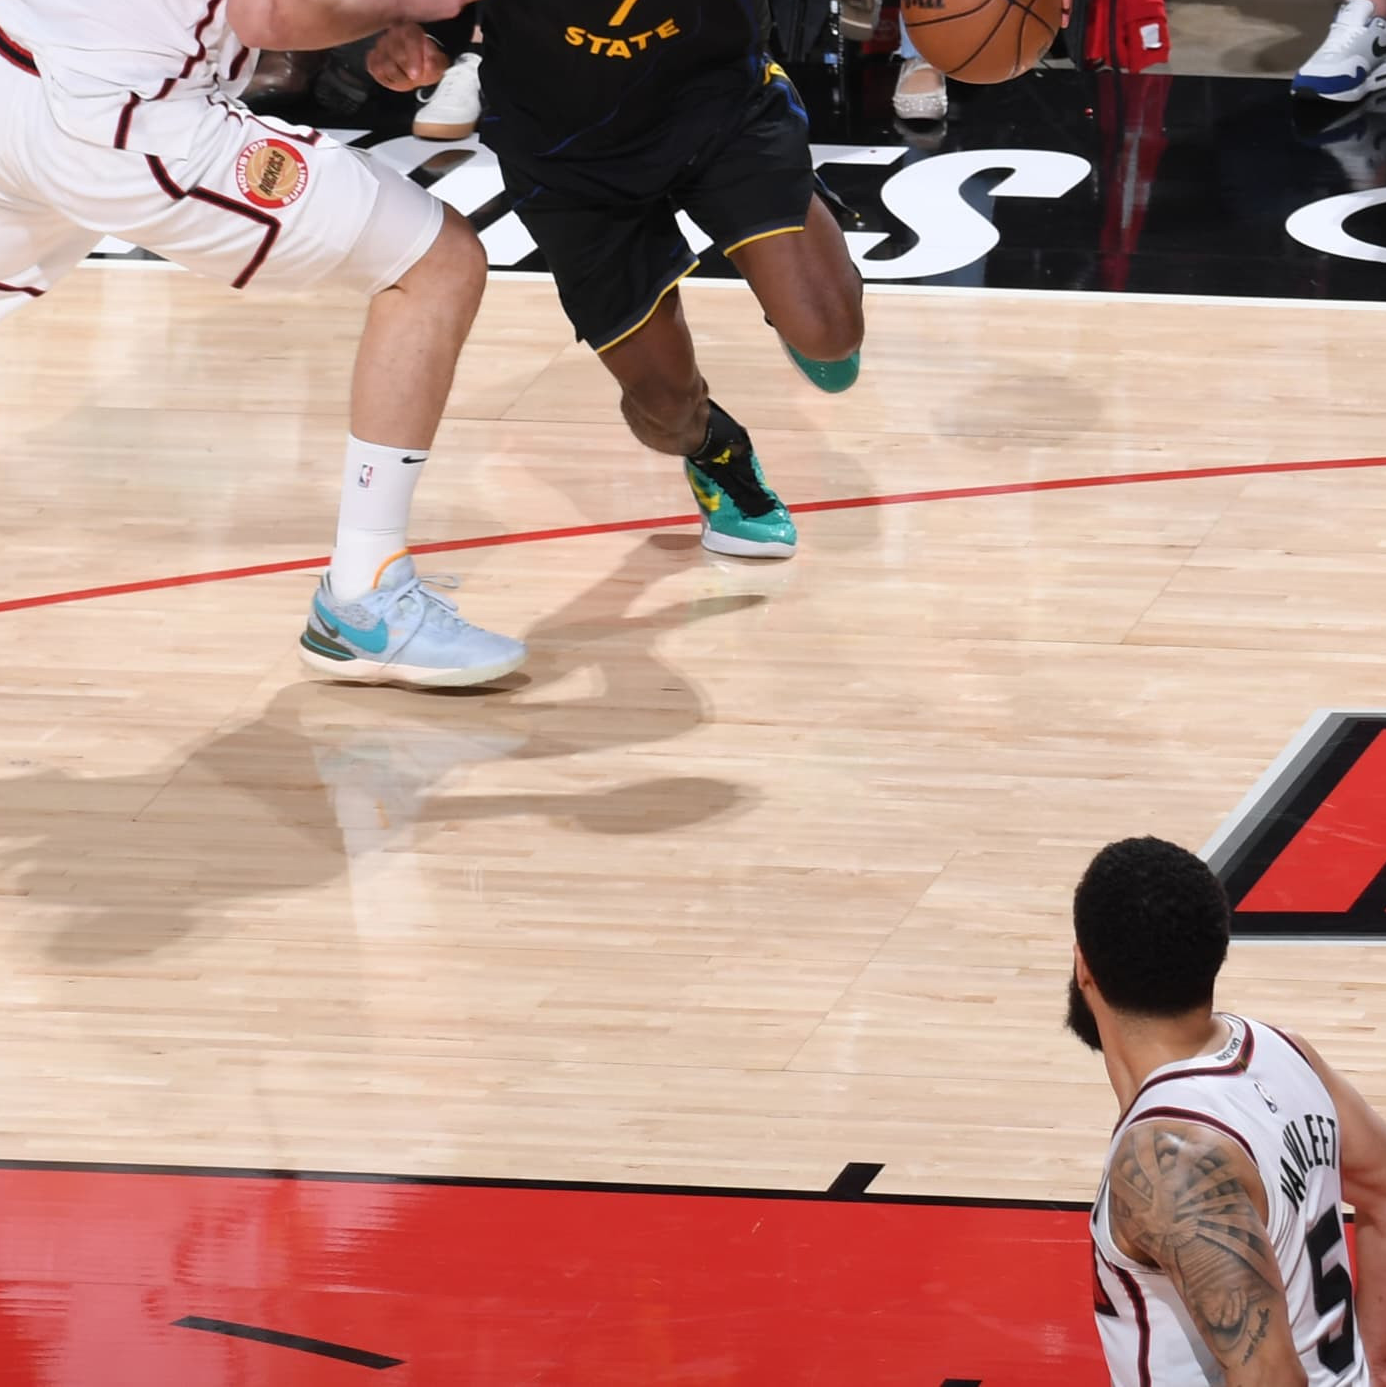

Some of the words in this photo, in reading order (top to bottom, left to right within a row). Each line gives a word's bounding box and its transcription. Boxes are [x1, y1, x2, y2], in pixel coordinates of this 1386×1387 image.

[564, 18, 681, 60] STATE
[237, 140, 268, 194] HOUSTON
[281, 161, 307, 206] SUMMIT
[1305, 1202, 1355, 1375] 5
